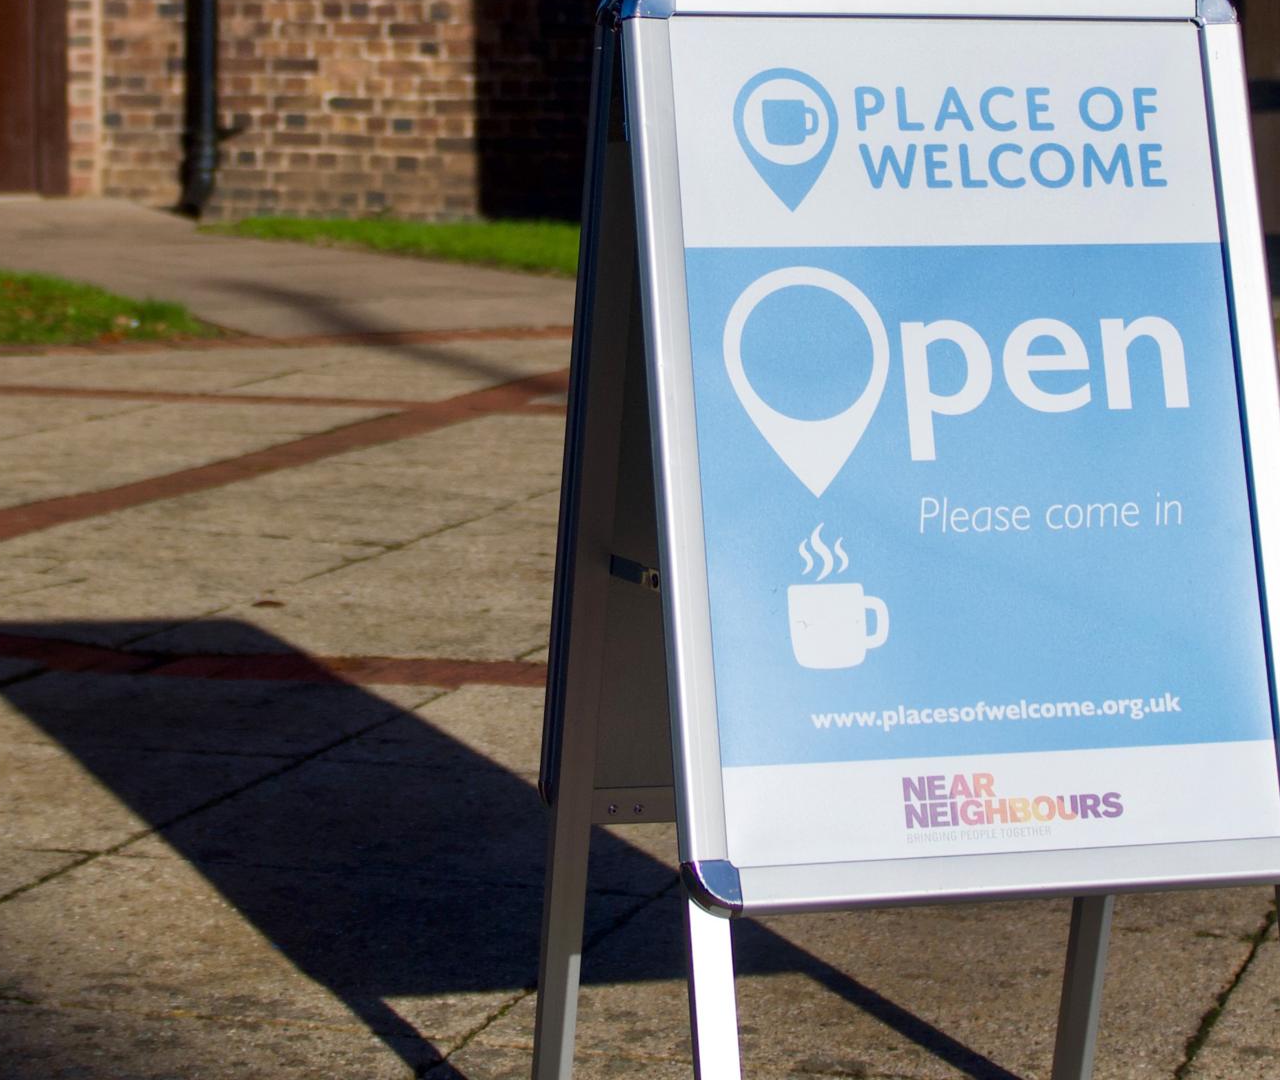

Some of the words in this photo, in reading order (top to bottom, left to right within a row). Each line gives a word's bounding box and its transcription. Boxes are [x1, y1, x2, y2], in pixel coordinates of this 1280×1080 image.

[854, 85, 1056, 132] PLACE
[1078, 85, 1159, 133] OF
[858, 142, 1168, 189] WELCOME
[919, 496, 1031, 535] Please
[1046, 499, 1140, 529] come
[1154, 492, 1183, 526] in
[811, 692, 1182, 732] www.placesofwelcome.org.uk
[901, 772, 995, 803] NEAR
[904, 791, 1125, 830] NEIGHBOURS
[906, 829, 958, 845] BRINGING
[960, 827, 999, 841] PEOPLE
[1000, 824, 1052, 839] TOGETHER
